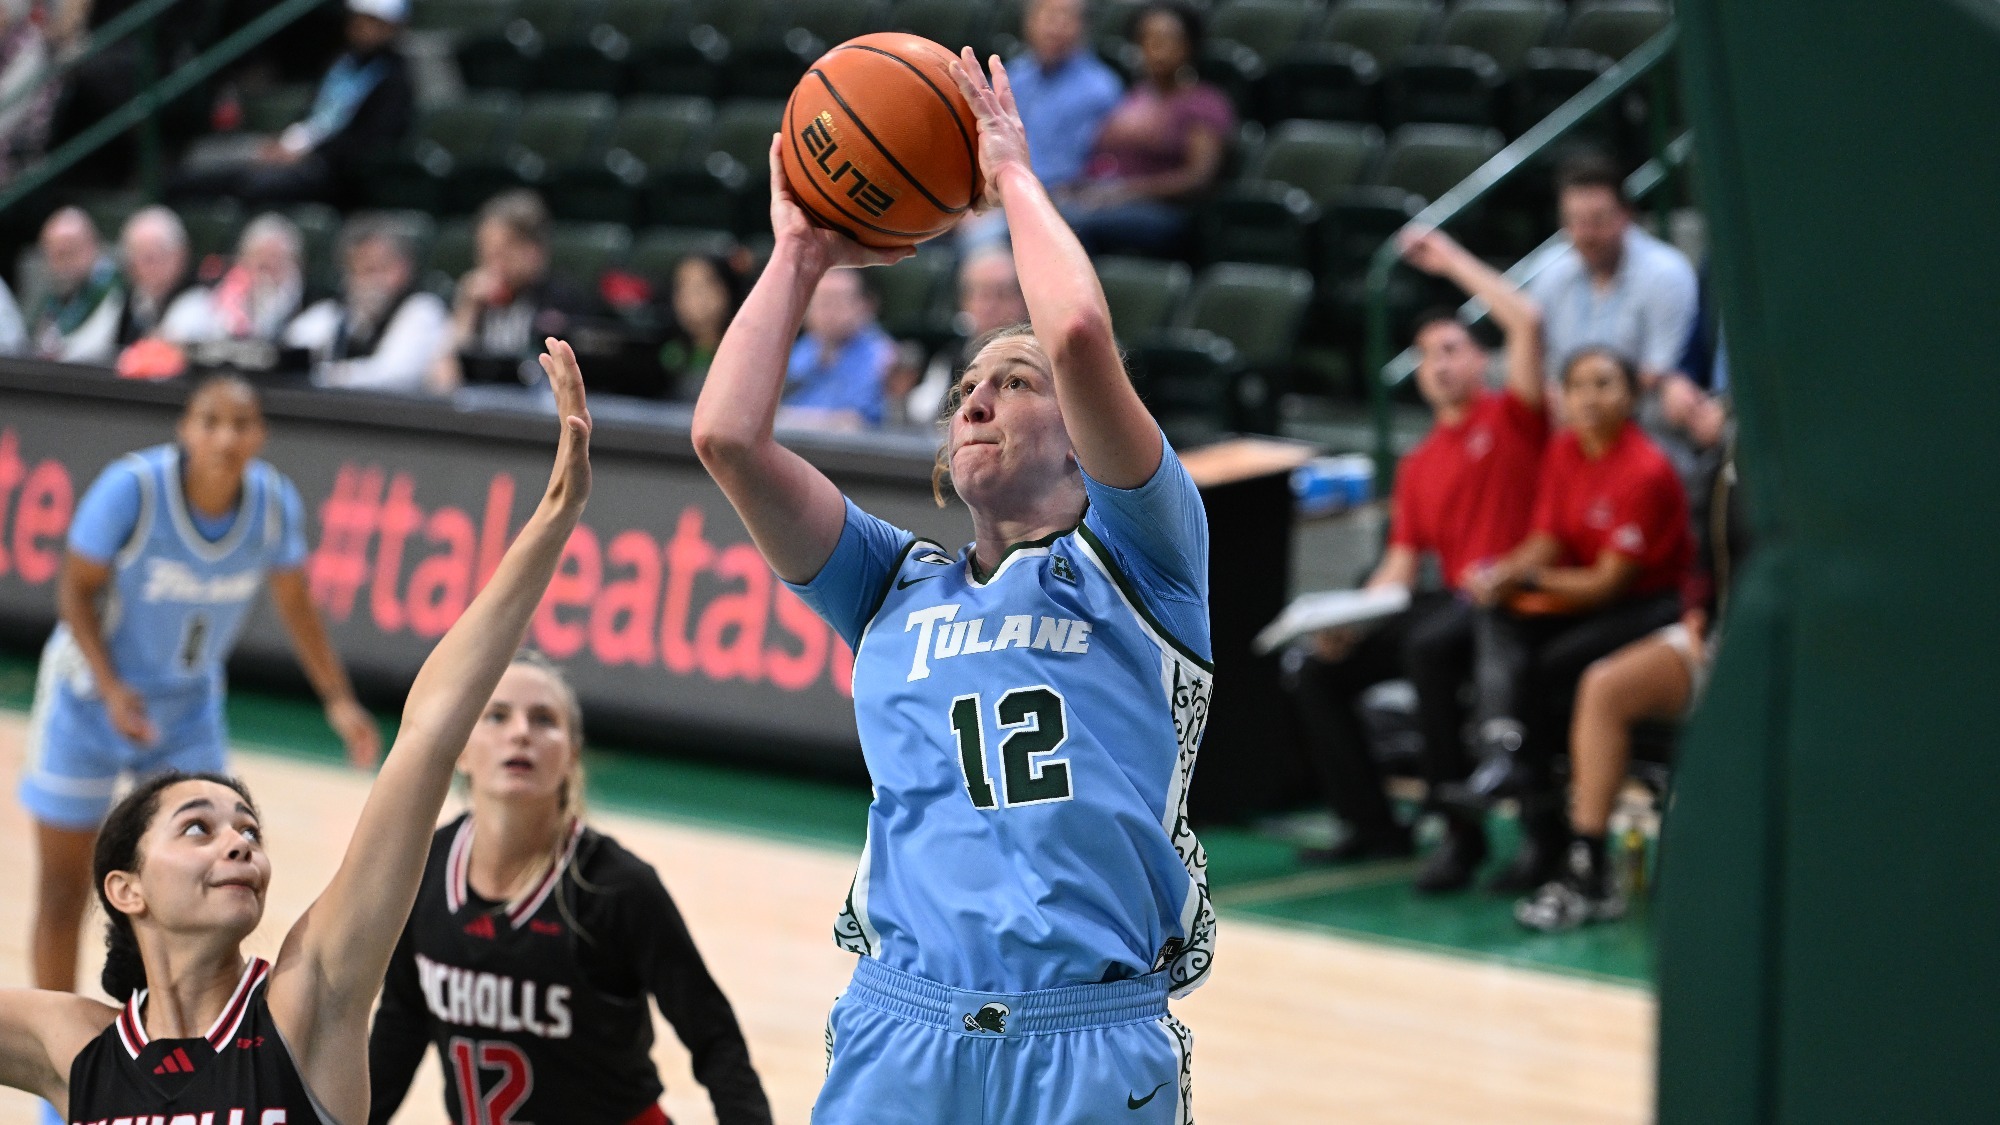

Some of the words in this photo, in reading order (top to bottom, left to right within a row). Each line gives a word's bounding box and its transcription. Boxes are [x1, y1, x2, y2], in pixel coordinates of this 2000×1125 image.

[801, 117, 896, 218] ELITE
[307, 460, 856, 700] #takeatas
[904, 603, 1094, 683] TULANE
[948, 684, 1074, 811] 12
[449, 1036, 535, 1125] 12
